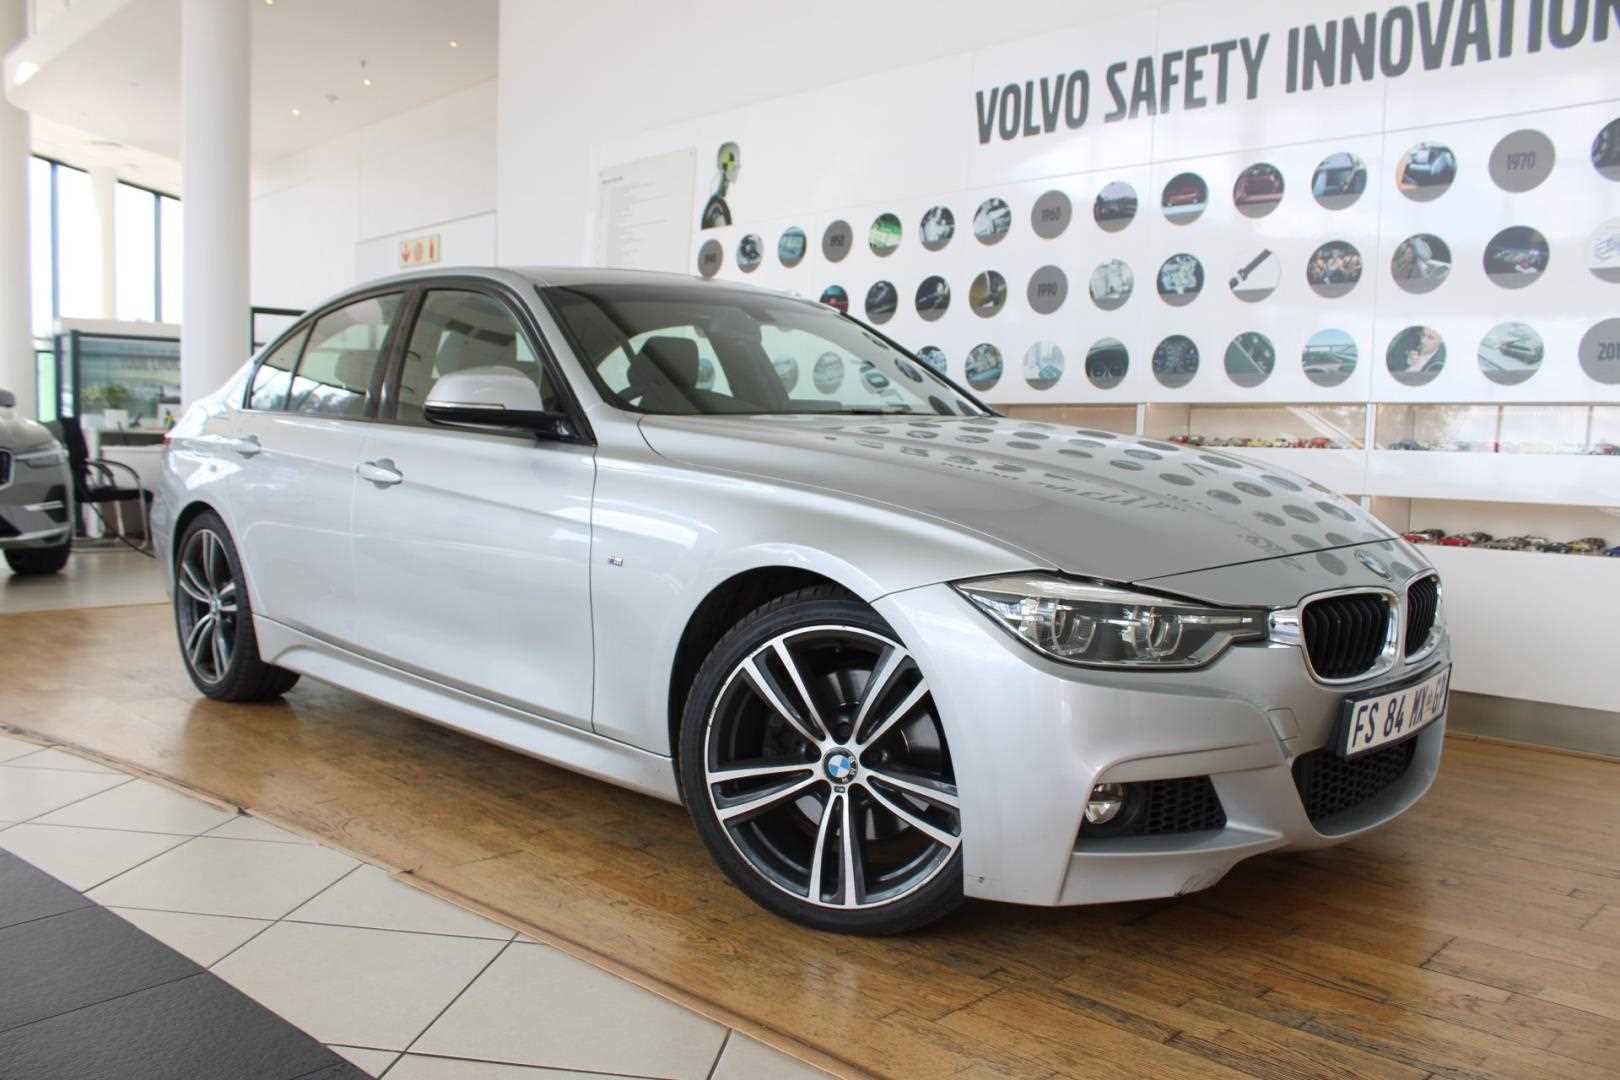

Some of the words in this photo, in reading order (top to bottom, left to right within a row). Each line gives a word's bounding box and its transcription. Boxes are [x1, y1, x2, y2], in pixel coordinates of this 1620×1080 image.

[976, 69, 1090, 145] VOLVO
[1104, 33, 1270, 123] SAFETY
[1286, 0, 1620, 93] INNOVATIO
[1507, 151, 1536, 170] 1970
[1352, 702, 1378, 748] FS
[1384, 695, 1406, 737] 84
